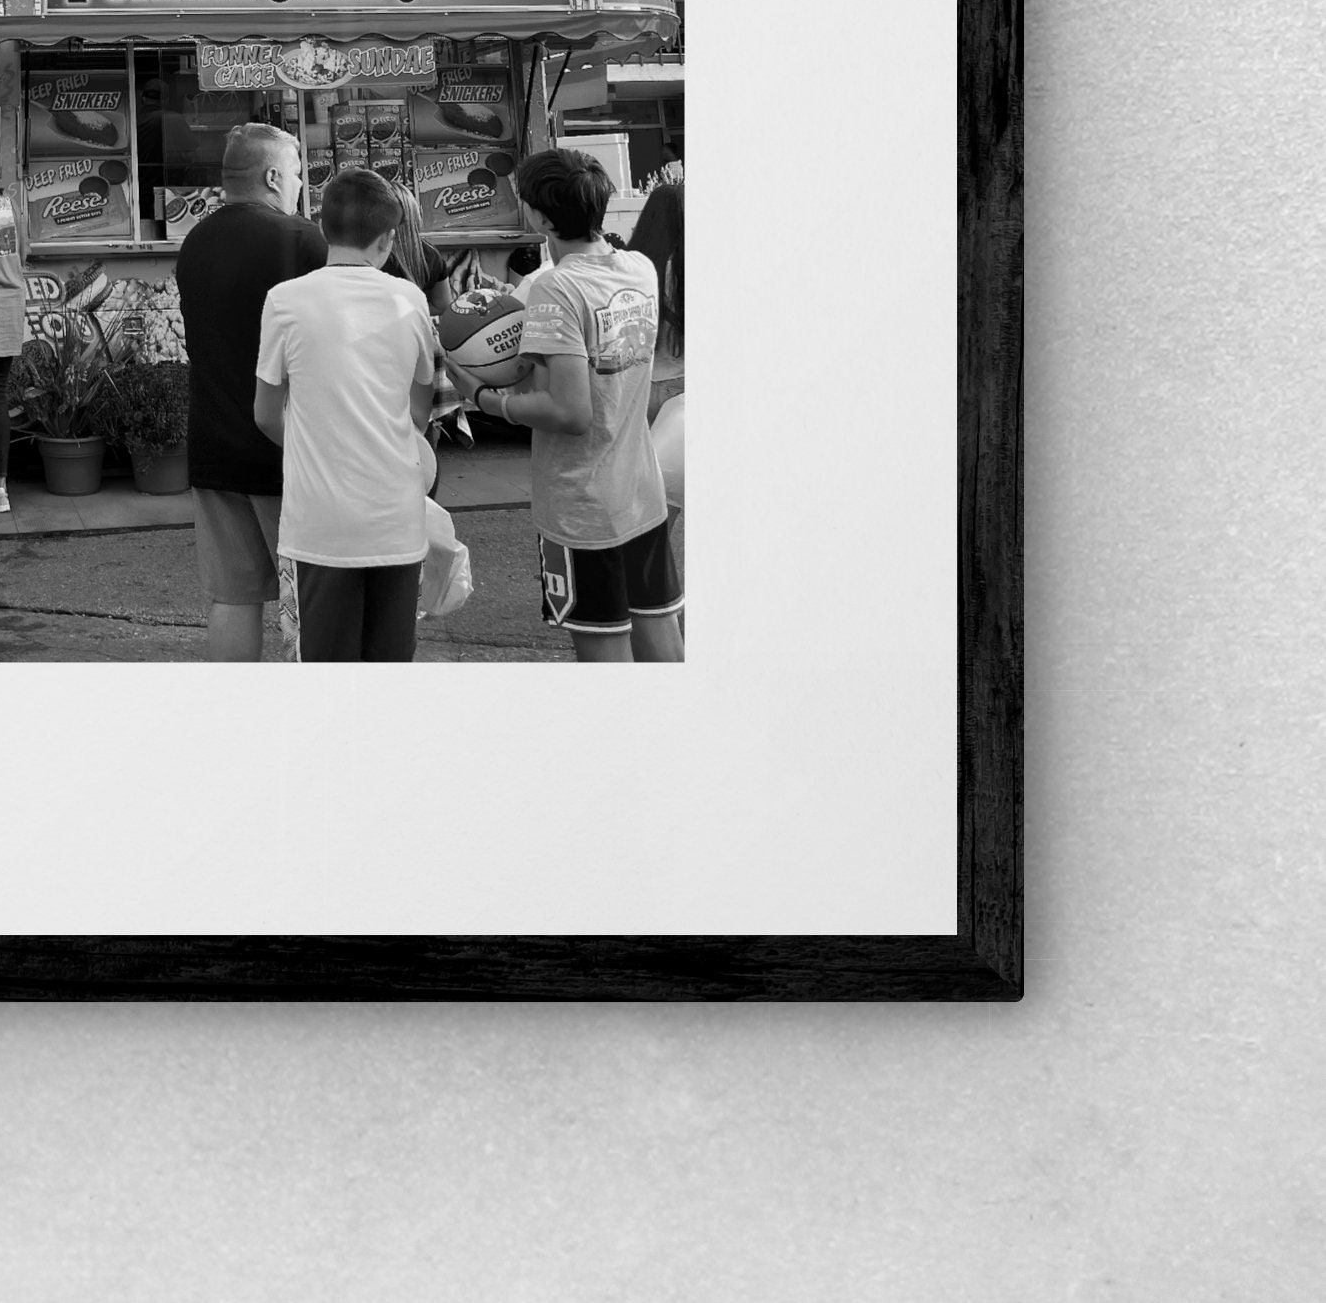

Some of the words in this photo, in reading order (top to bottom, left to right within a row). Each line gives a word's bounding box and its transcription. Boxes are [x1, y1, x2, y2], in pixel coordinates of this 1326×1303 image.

[202, 45, 284, 68] FUNNEL
[348, 46, 436, 78] SUNDAE
[56, 73, 90, 94] FRIED
[214, 65, 275, 88] CAKE
[53, 92, 121, 110] SNICKERS
[440, 85, 503, 103] SNICKERS
[24, 168, 56, 191] DEEP
[58, 158, 93, 183] FRIED
[414, 160, 445, 182] DEEP
[447, 150, 480, 173] FRIED
[485, 320, 524, 347] BOSTON
